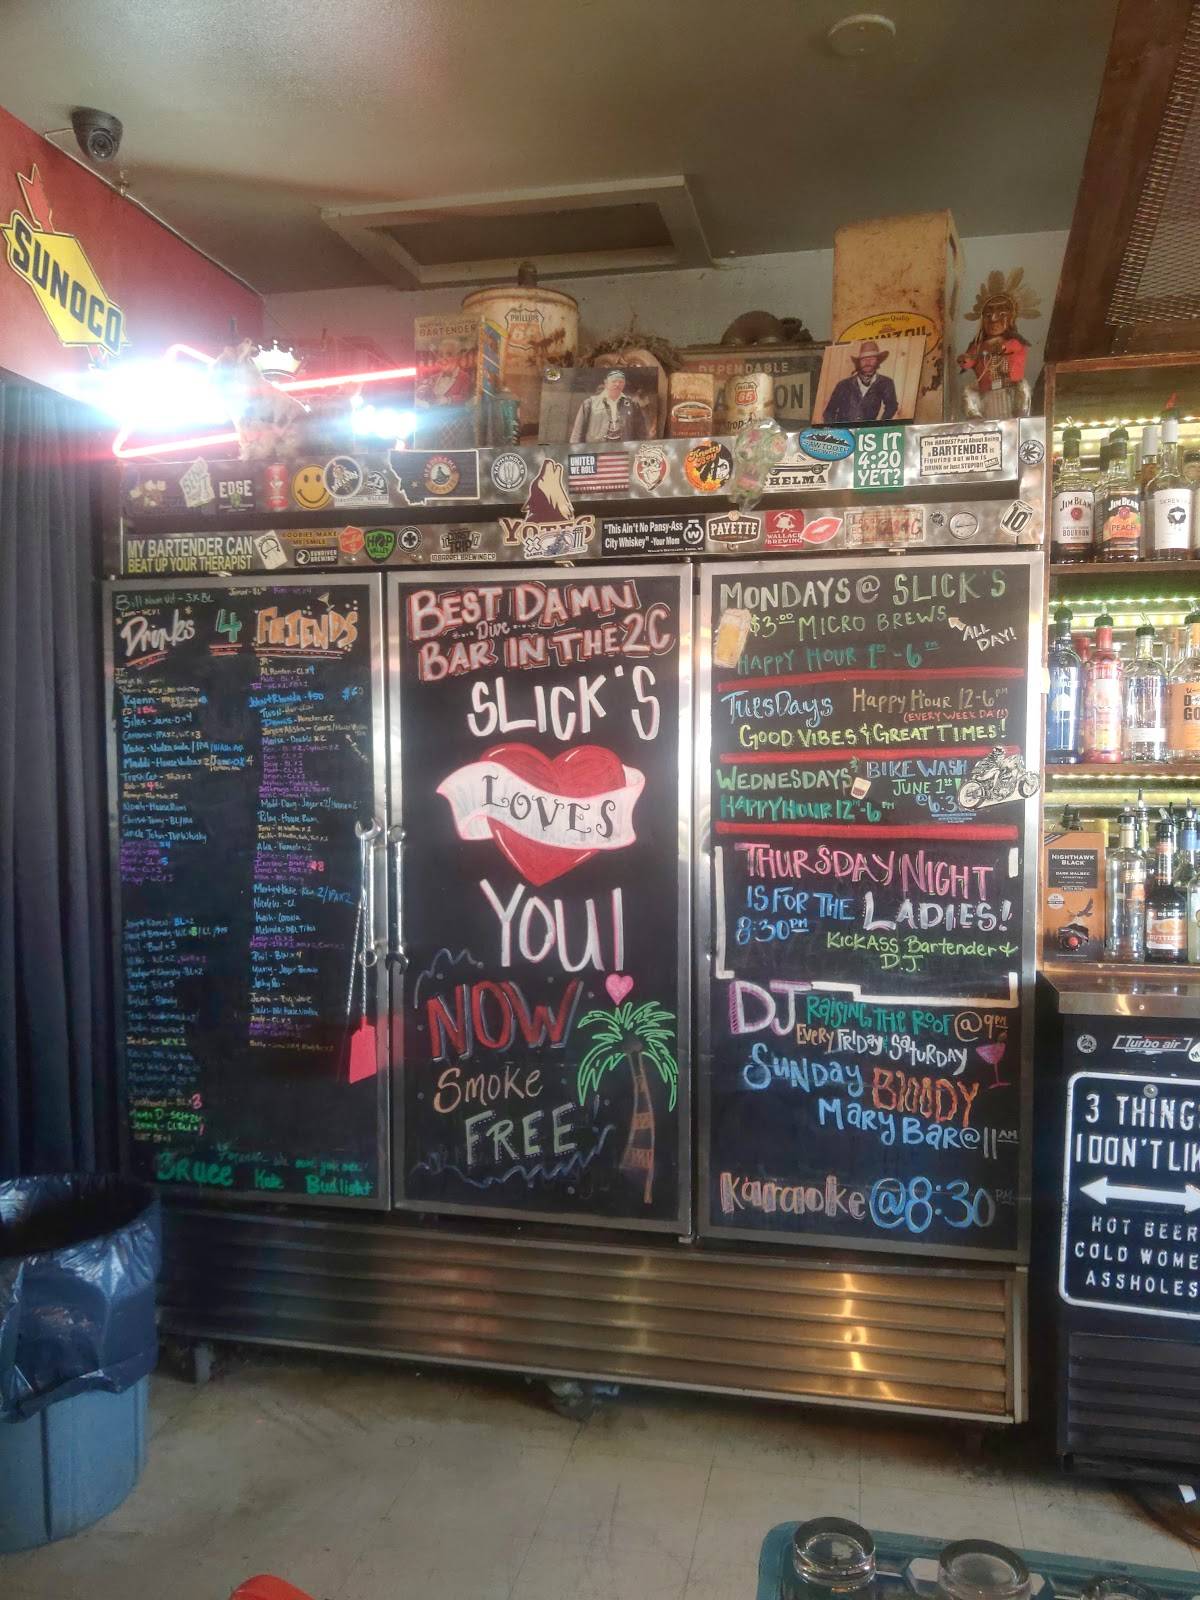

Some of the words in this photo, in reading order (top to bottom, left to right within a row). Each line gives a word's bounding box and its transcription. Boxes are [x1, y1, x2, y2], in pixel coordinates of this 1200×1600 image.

[12, 218, 123, 355] SUNOCO
[419, 324, 477, 337] BARTENDER
[698, 362, 789, 374] DEPENDABLE
[858, 434, 877, 451] IS
[883, 432, 901, 450] IT
[932, 444, 988, 456] BARTENDER
[570, 456, 595, 466] UNITED
[571, 466, 579, 474] WE
[580, 466, 595, 474] ROLL
[858, 451, 901, 469] 4:20
[858, 468, 900, 486] YET?
[218, 480, 253, 498] EDGE
[1060, 499, 1073, 511] JIM
[1074, 496, 1092, 510] BEAM
[1108, 498, 1121, 511] JIM
[1121, 496, 1139, 510] BEAM
[622, 523, 639, 534] Ain't
[639, 522, 649, 532] No
[649, 521, 683, 534] Pansy-Ass
[711, 522, 757, 536] PAYETTE
[1062, 529, 1090, 537] BOURBON
[127, 540, 145, 558] MY
[147, 537, 223, 557] BARTENDER
[226, 536, 253, 555] CAN
[367, 535, 392, 547] HOP
[605, 538, 618, 550] City
[666, 537, 680, 545] Mom
[128, 559, 154, 573] BEAT
[155, 558, 168, 572] UP
[171, 557, 197, 572] YOUR
[199, 555, 253, 571] THERAPIST
[720, 576, 851, 611] MONDAYS
[892, 569, 1006, 606] SLICK'S
[408, 588, 503, 640] BEST
[510, 580, 641, 628] DAMN
[120, 609, 196, 656] Drinks
[215, 609, 243, 642] 4
[257, 607, 358, 649] FRIENDS
[476, 621, 511, 640] Dive
[798, 615, 866, 641] MICRO
[877, 605, 948, 632] BREWS
[962, 624, 990, 642] ALL
[419, 640, 498, 683] BAR
[505, 633, 549, 669] IN
[549, 622, 624, 667] THE
[622, 603, 675, 658] 2C
[977, 628, 1017, 651] DAY!
[737, 650, 795, 675] HAPPY
[806, 645, 857, 672] HOUR
[467, 665, 660, 741] SLICK'S
[852, 687, 906, 714] Happy
[910, 690, 952, 709] Hour
[739, 725, 792, 750] GOOD
[798, 725, 857, 746] VIBES
[873, 724, 933, 744] GREAT
[935, 718, 1006, 742] TIMES!
[716, 766, 851, 791] WEDNESDAYS
[866, 760, 916, 778] BIKE
[916, 759, 968, 776] WASH
[892, 779, 931, 796] JUNE
[481, 775, 616, 840] LOVES
[720, 796, 785, 820] HAPPY
[785, 798, 832, 820] HOUR
[735, 843, 895, 885] THURSDAY
[900, 850, 994, 900] NIGHT
[747, 885, 766, 911] IS
[772, 887, 807, 913] FOR
[813, 891, 855, 920] THE
[863, 891, 1012, 932] LADIES!
[480, 879, 624, 972] YOU!
[904, 936, 997, 957] Bartender
[729, 979, 813, 1036] DJ
[427, 978, 584, 1062] NOW
[1125, 1036, 1160, 1049] Turbo
[1162, 1040, 1181, 1049] air
[433, 1067, 544, 1114] Smoke
[1085, 1094, 1100, 1124] 3
[1116, 1095, 1200, 1131] THING
[465, 1102, 577, 1167] FREE
[1075, 1133, 1082, 1163] I
[1087, 1134, 1163, 1170] DON'T
[1168, 1140, 1200, 1173] LIK
[1091, 1216, 1131, 1235] HOT
[1144, 1222, 1198, 1242] BEER
[1074, 1241, 1128, 1263] COLD
[1140, 1249, 1200, 1271] WOME
[1085, 1270, 1199, 1298] ASSHOLES
